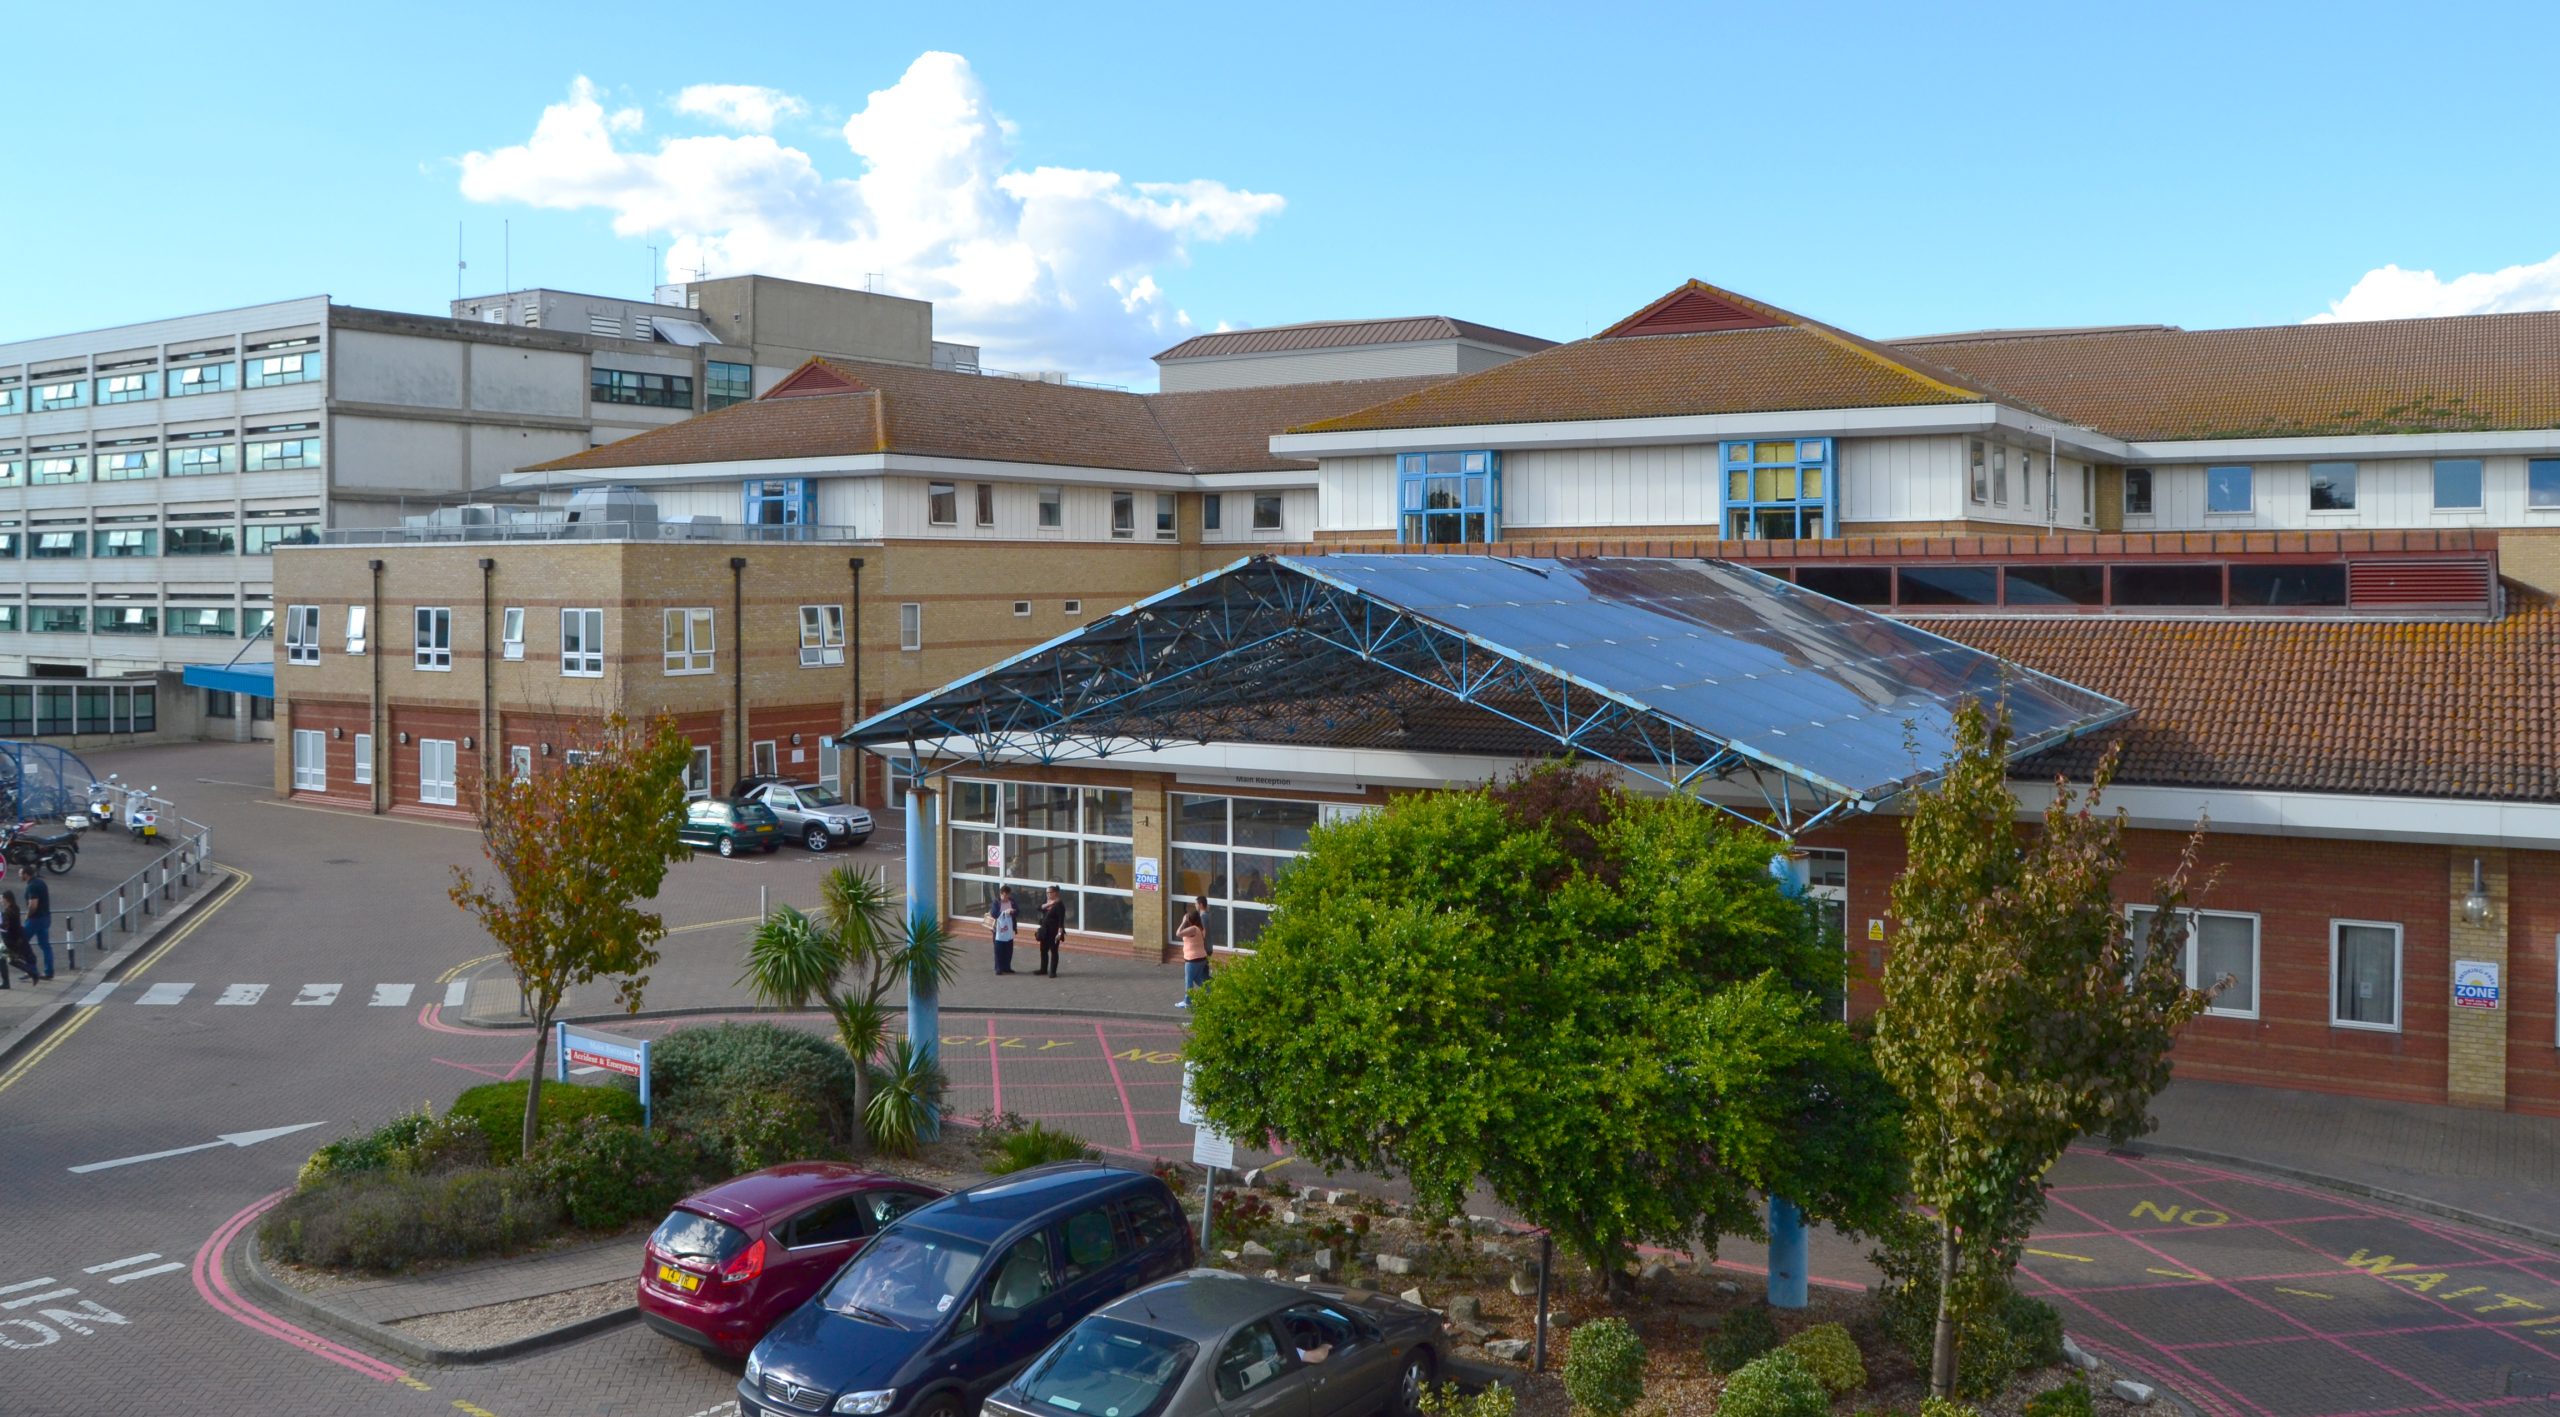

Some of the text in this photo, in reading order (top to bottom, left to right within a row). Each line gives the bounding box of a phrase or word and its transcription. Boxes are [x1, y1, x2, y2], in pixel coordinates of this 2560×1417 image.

[1235, 775, 1291, 786] Main Reception
[1136, 874, 1157, 884] ZONE
[2456, 986, 2496, 998] ZONE
[573, 1051, 599, 1064] Accident
[606, 1058, 639, 1075] Emergency
[1113, 1048, 1183, 1064] NO
[2128, 1200, 2230, 1227] NO
